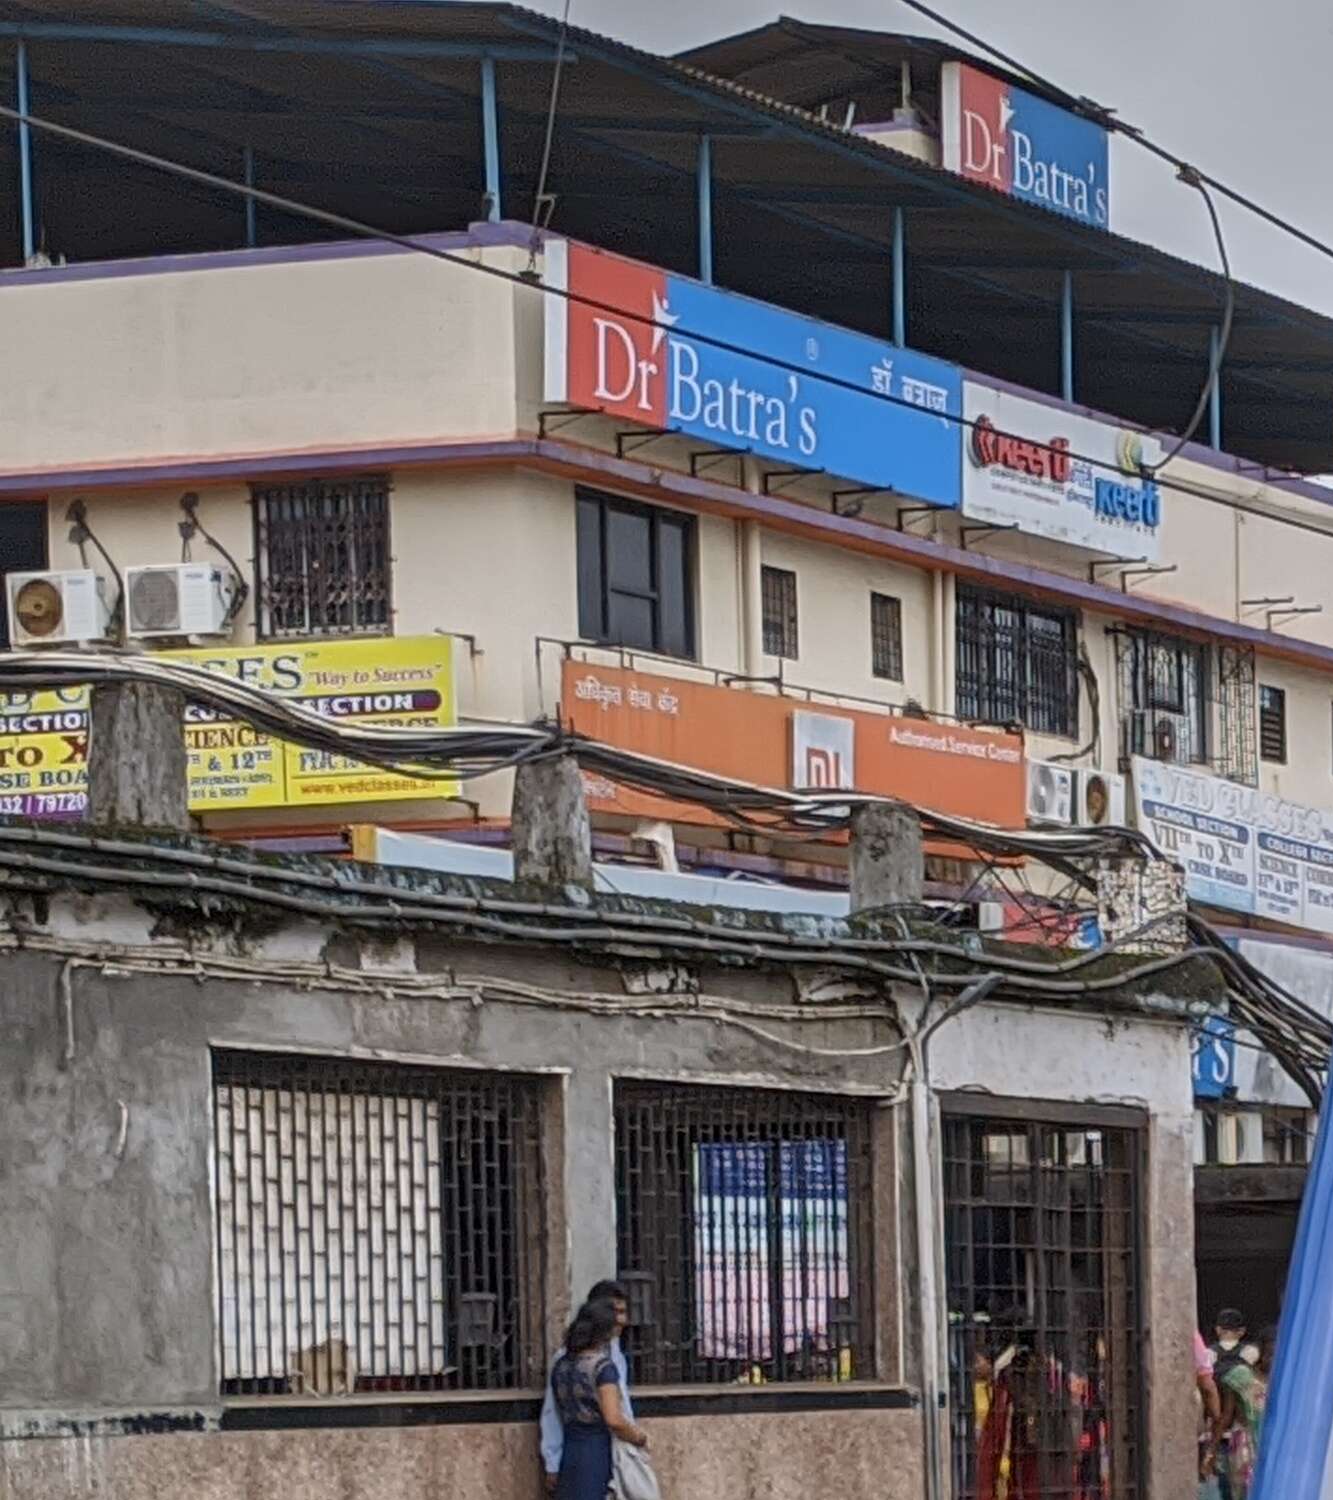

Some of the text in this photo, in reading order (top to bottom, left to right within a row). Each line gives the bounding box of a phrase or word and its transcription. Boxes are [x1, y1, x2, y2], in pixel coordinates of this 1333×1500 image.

[963, 109, 1107, 224] Dr Batra's
[592, 317, 817, 456] Dr Batra's
